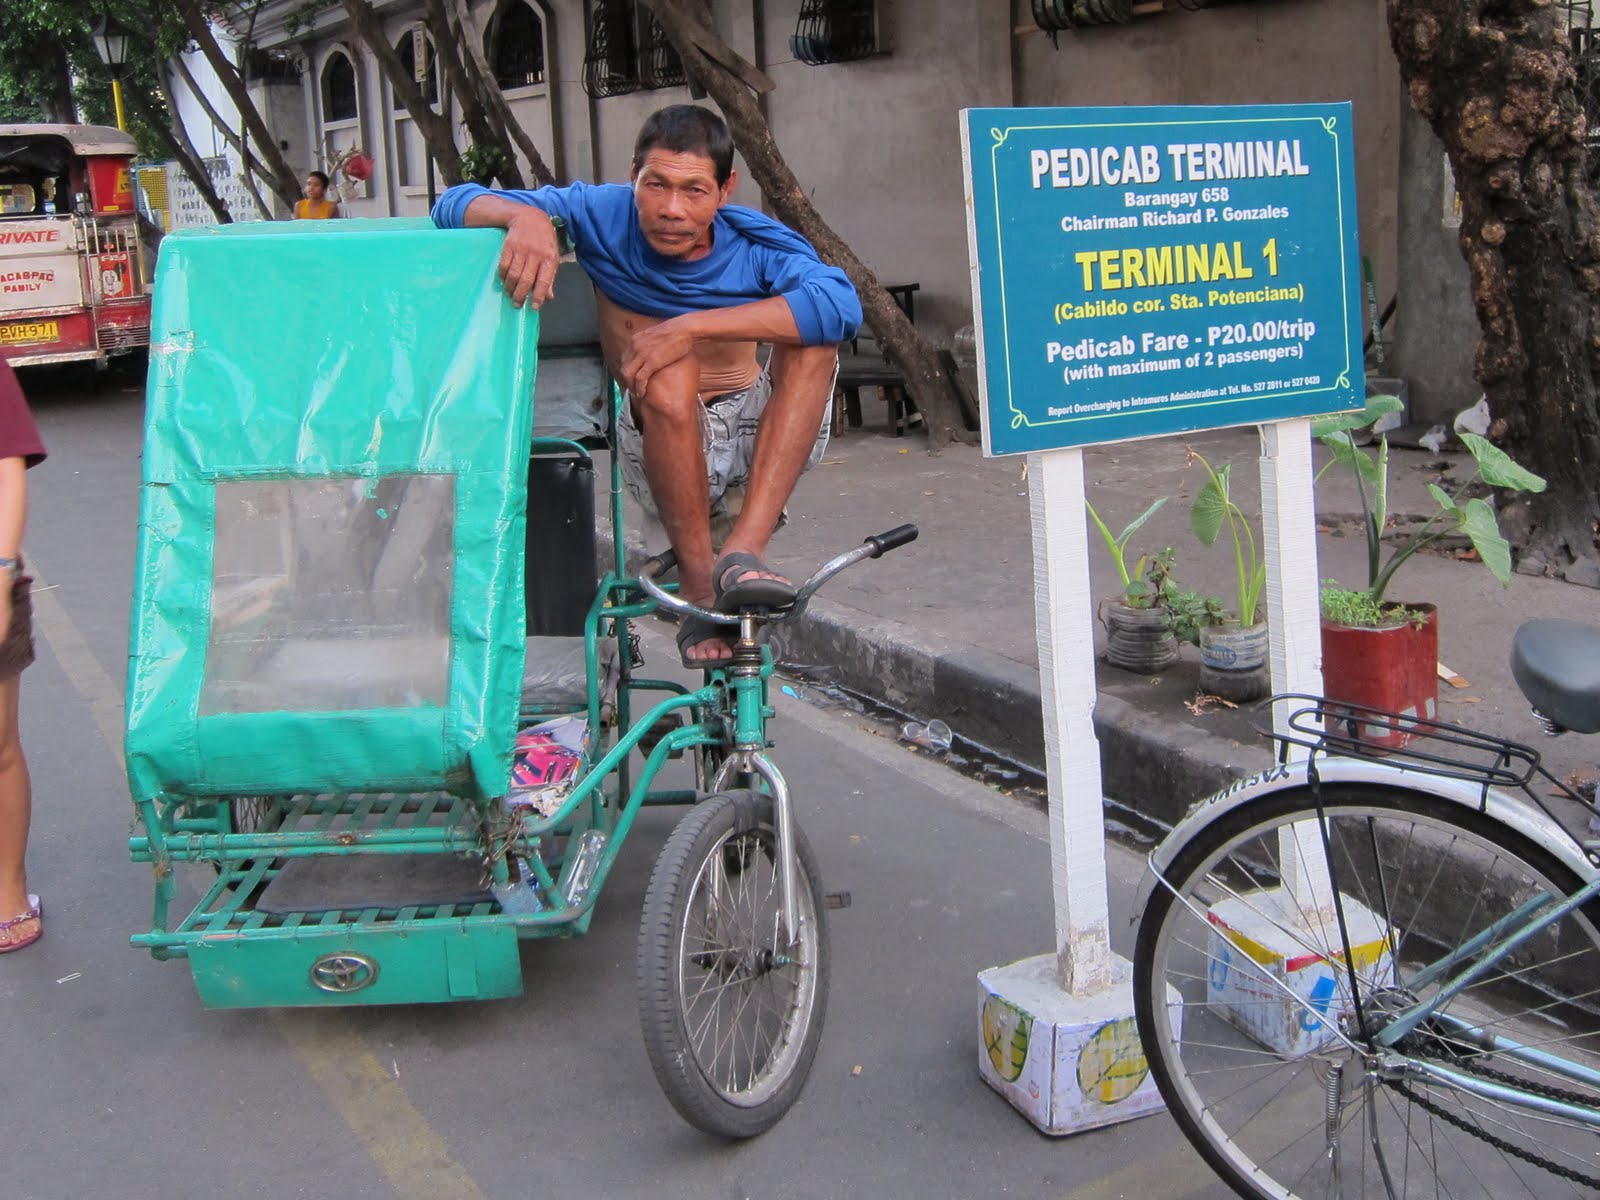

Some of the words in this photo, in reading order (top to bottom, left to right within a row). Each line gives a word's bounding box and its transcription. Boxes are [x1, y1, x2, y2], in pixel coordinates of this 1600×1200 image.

[1031, 145, 1161, 189] PEDICAB
[1168, 139, 1309, 181] TERMINAL
[1061, 213, 1138, 232] Chairman
[1143, 208, 1202, 227] Richard
[1206, 208, 1219, 223] P.
[1222, 204, 1289, 222] Gonzales
[1124, 190, 1198, 208] Barangay
[1202, 187, 1229, 203] 658
[1075, 241, 1254, 293] TERMINAL
[1262, 238, 1279, 277] 1
[4, 283, 41, 293] FAMILY
[1054, 299, 1128, 325] (Cabildo
[1133, 299, 1165, 314] cor.
[1170, 292, 1204, 311] Sta.
[1208, 282, 1304, 307] Potenciana)
[1046, 335, 1136, 363] Pedicab
[1141, 331, 1190, 354] Fare
[1208, 318, 1316, 346] P20.00/trip
[1063, 364, 1104, 385] (with
[1108, 354, 1181, 377] maximum
[1185, 351, 1201, 368] of
[1204, 350, 1215, 366] 2
[1218, 342, 1304, 368] passengers)
[1048, 405, 1073, 418] Report
[1074, 398, 1122, 412] Overcharging
[1122, 398, 1130, 408] to
[1131, 394, 1169, 407] Intramuros
[1169, 387, 1219, 402] Administration
[1219, 386, 1228, 396] at
[1228, 384, 1241, 395] Tel.
[1241, 384, 1253, 394] No.
[1253, 381, 1266, 392] 527
[1267, 379, 1283, 390] 2811
[1283, 380, 1291, 388] or
[1292, 376, 1304, 388] 527
